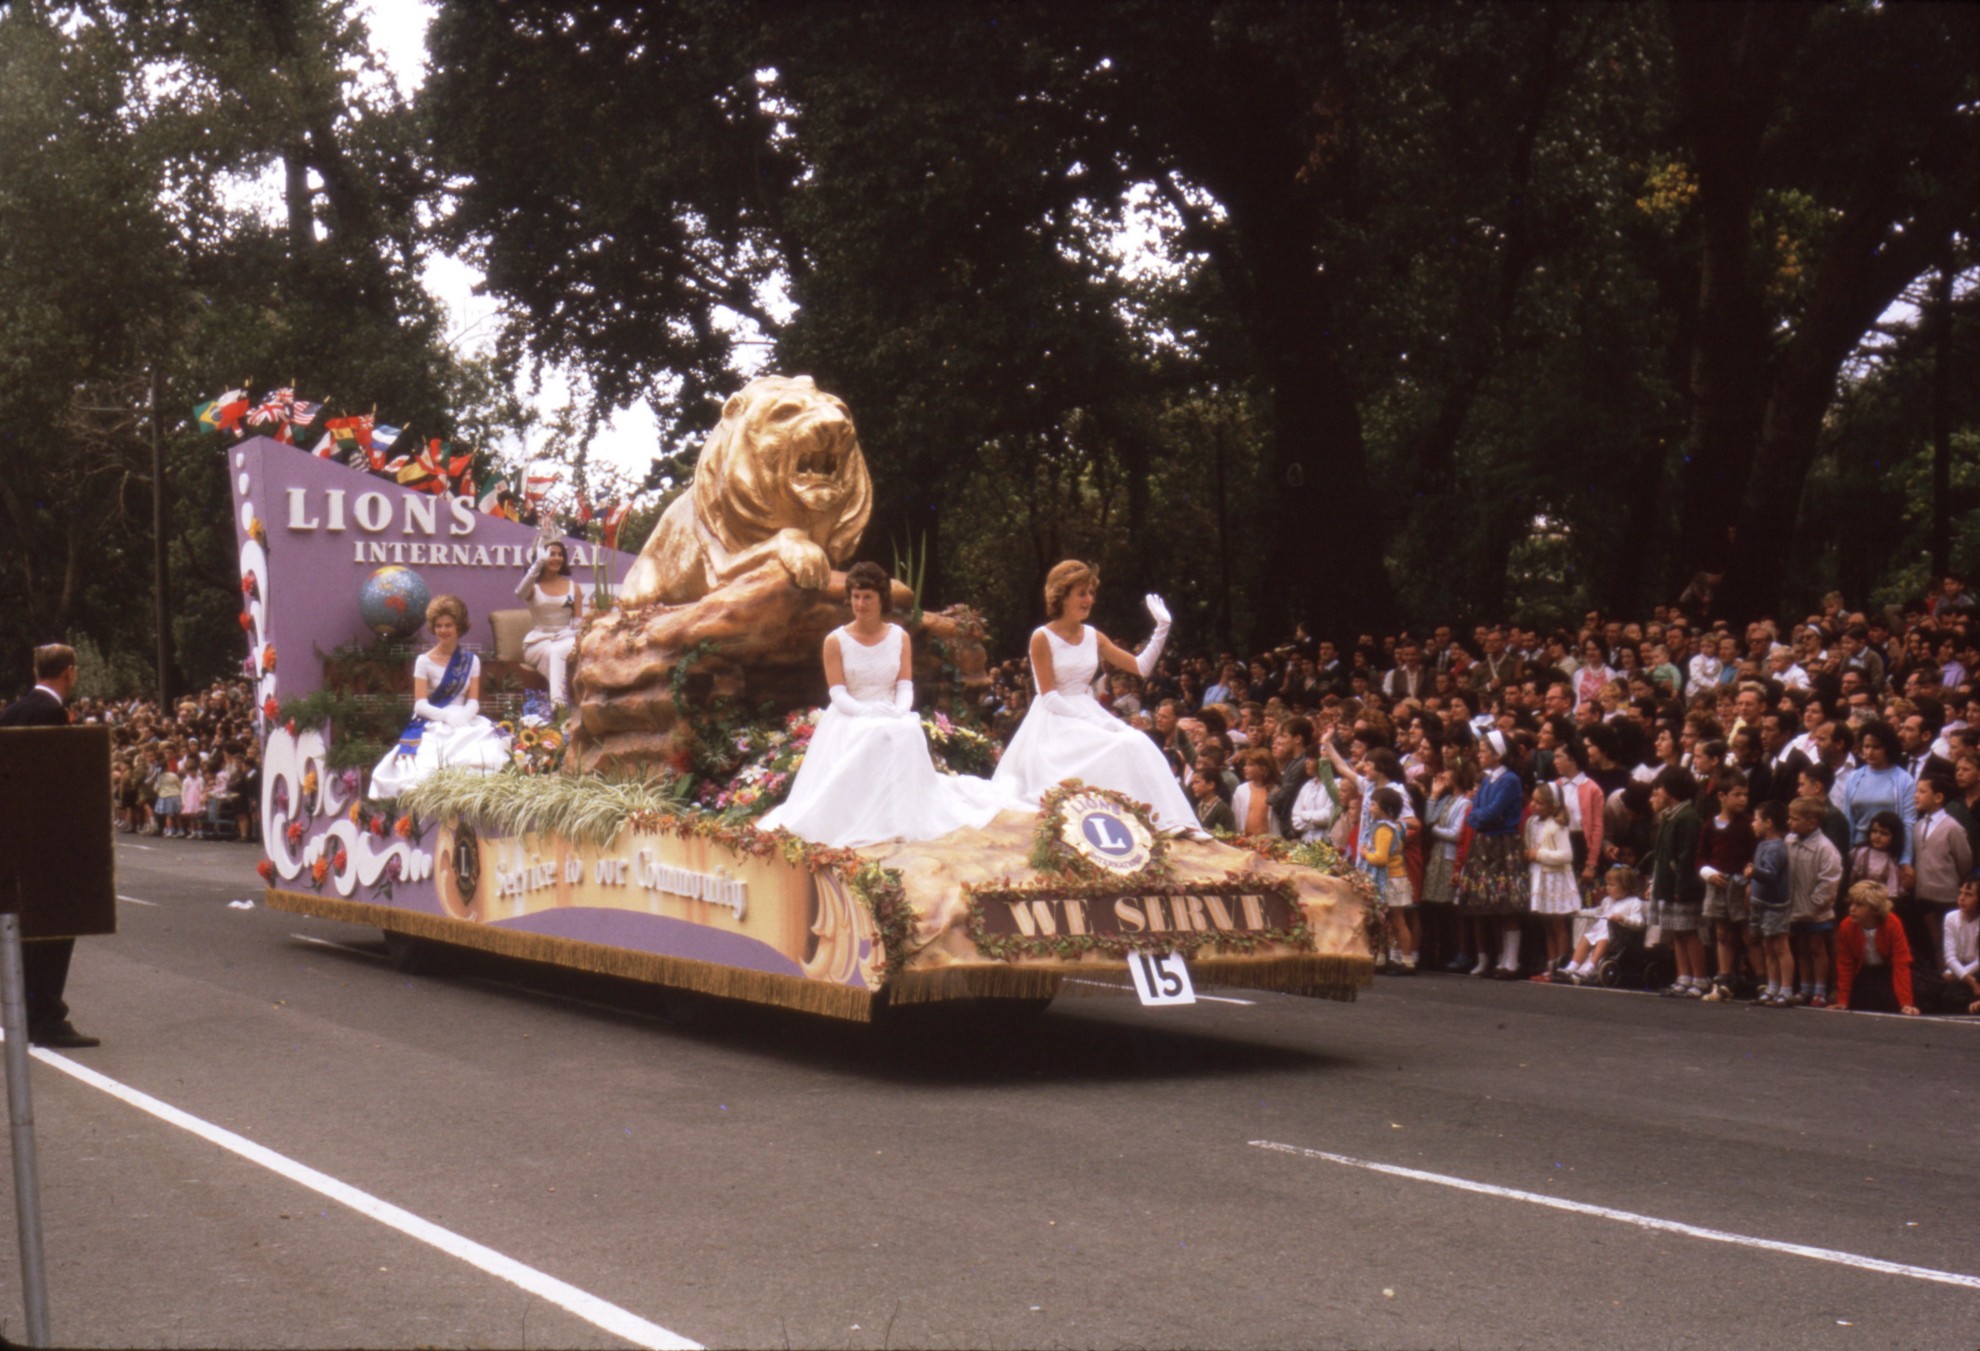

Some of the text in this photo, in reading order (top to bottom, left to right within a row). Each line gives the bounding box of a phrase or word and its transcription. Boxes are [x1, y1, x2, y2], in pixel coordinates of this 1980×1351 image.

[286, 487, 476, 535] LIONS
[353, 541, 605, 567] INTERNATIAL
[1088, 818, 1127, 848] L
[460, 846, 470, 877] L
[1003, 895, 1271, 937] WE SERVE
[1138, 953, 1184, 998] 15
